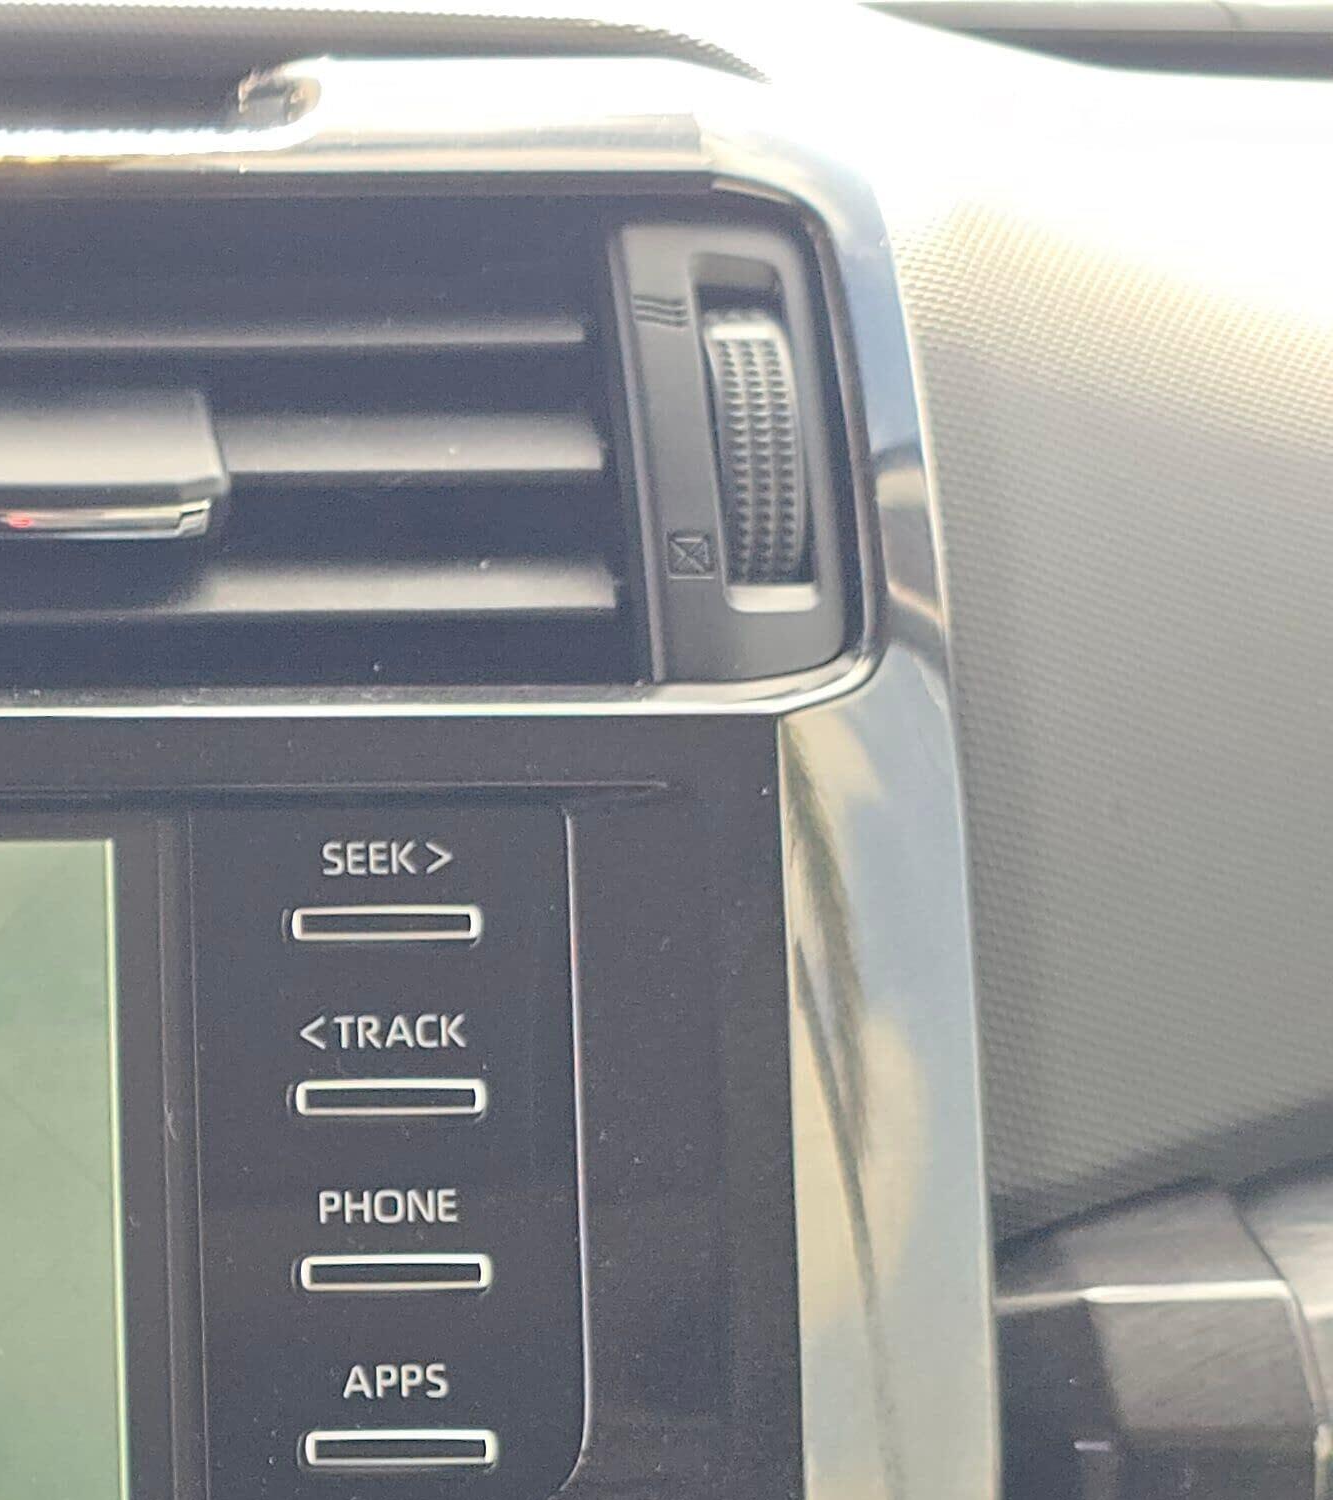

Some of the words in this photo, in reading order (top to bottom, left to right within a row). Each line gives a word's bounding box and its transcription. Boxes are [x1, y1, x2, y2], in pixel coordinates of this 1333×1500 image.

[322, 841, 417, 877] SEEK
[334, 1013, 467, 1050] TRACK
[318, 1188, 459, 1225] PHONE
[342, 1363, 450, 1399] APPS
